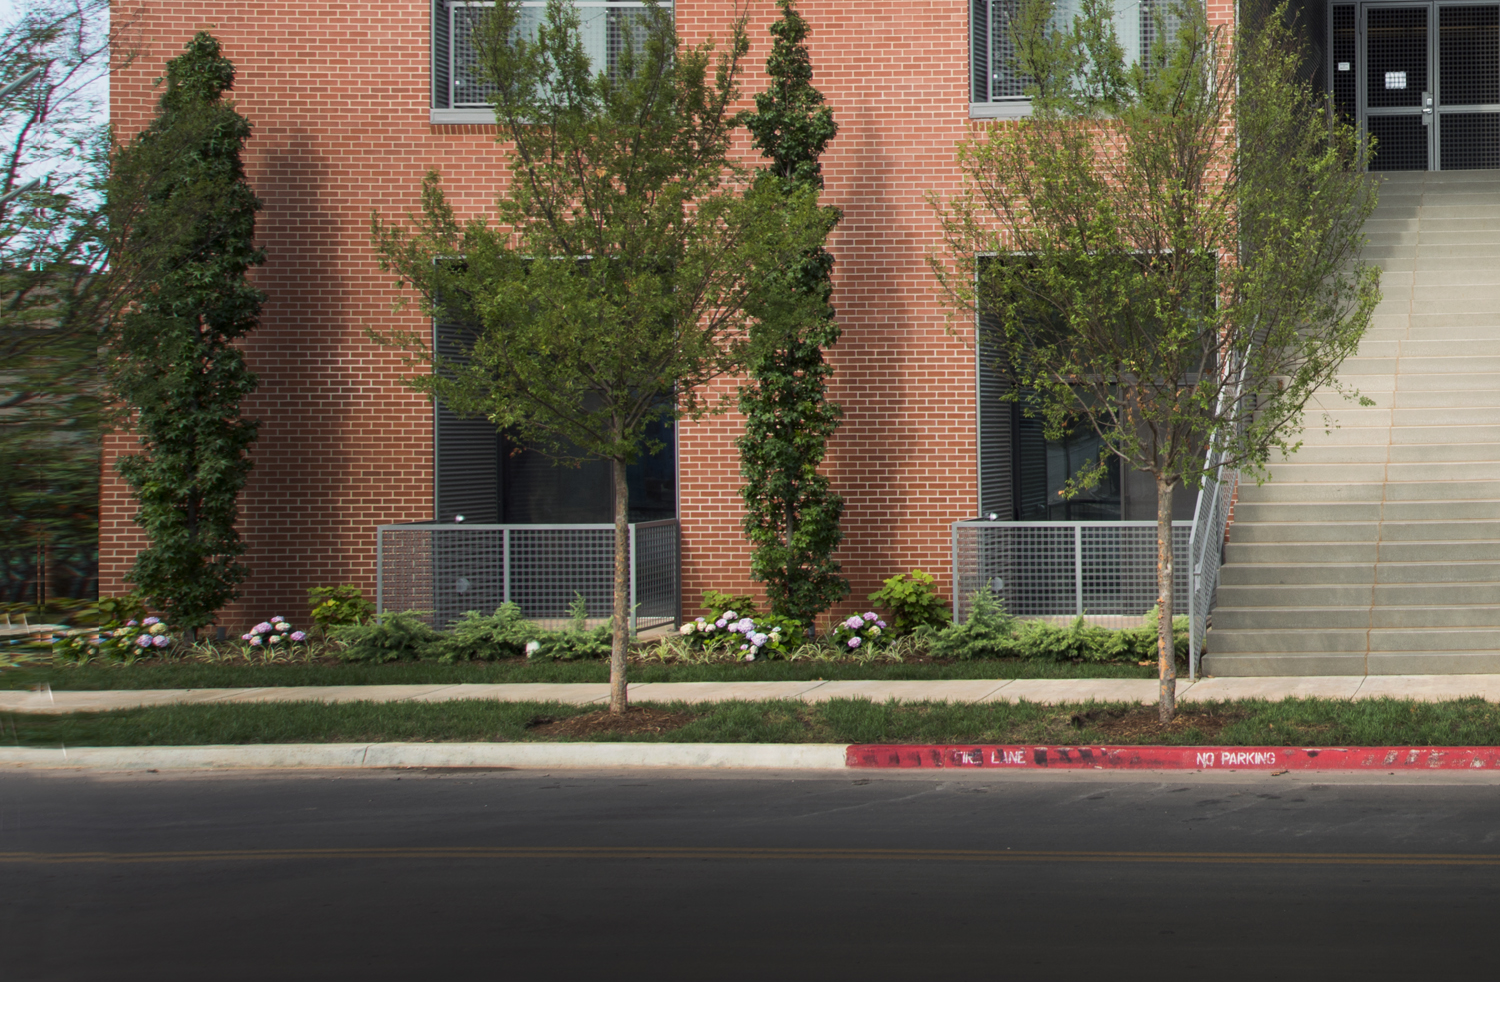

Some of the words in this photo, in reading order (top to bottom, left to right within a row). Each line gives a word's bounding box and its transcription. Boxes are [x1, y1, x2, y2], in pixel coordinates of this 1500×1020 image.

[991, 751, 1026, 764] LANE
[1197, 752, 1215, 767] NO
[1221, 752, 1276, 765] PARKING
